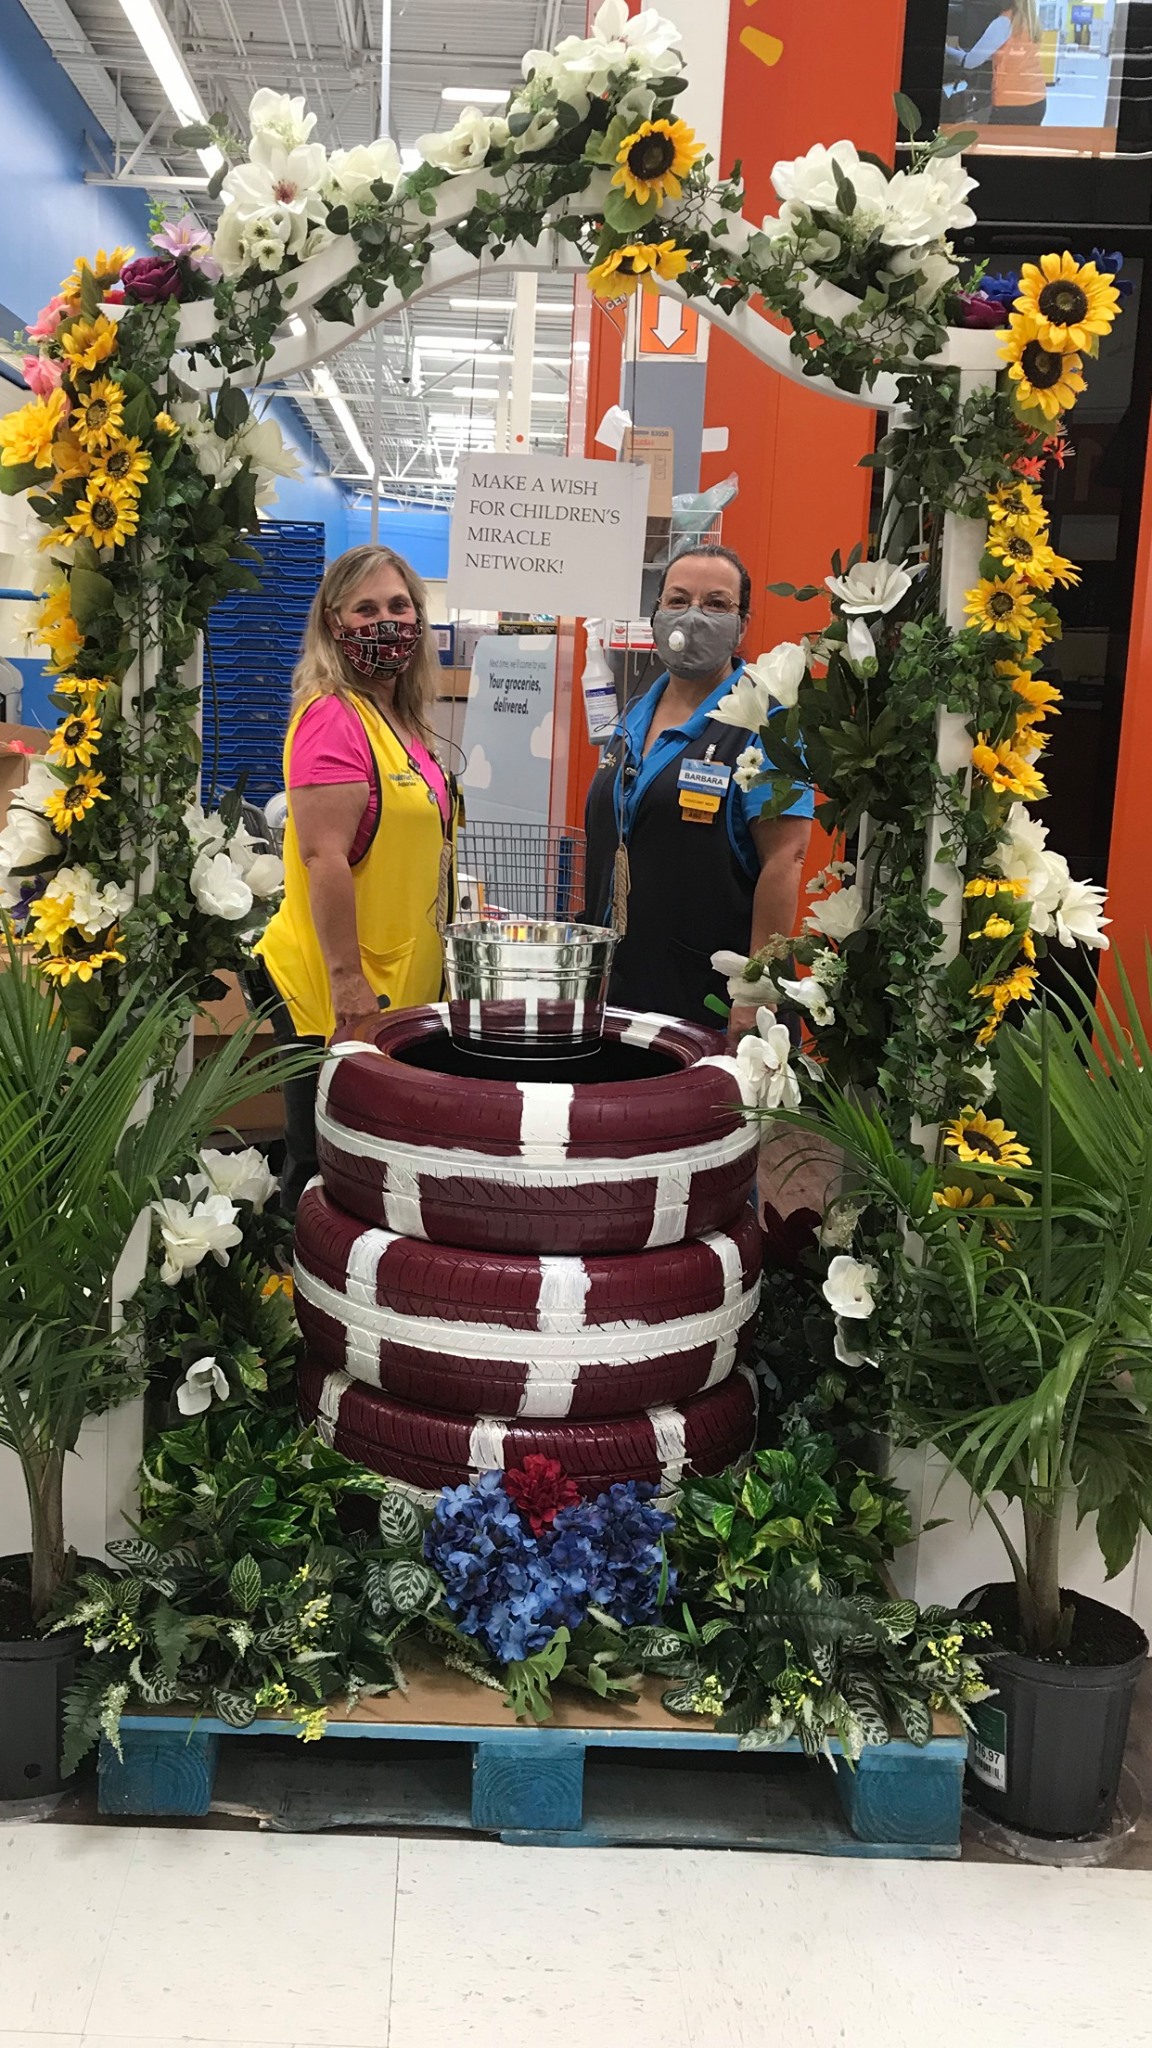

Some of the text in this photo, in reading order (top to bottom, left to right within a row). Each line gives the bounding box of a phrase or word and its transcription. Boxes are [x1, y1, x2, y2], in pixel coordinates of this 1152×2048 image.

[471, 473, 598, 496] MAKE A WISH
[469, 500, 621, 525] FOR CHILDREN'S
[467, 526, 551, 547] MIRACLE
[465, 552, 564, 574] NETWORK!
[489, 672, 504, 689] Your
[505, 674, 541, 695] groceries,
[493, 696, 529, 715] delivered.
[684, 772, 724, 786] BARBARA
